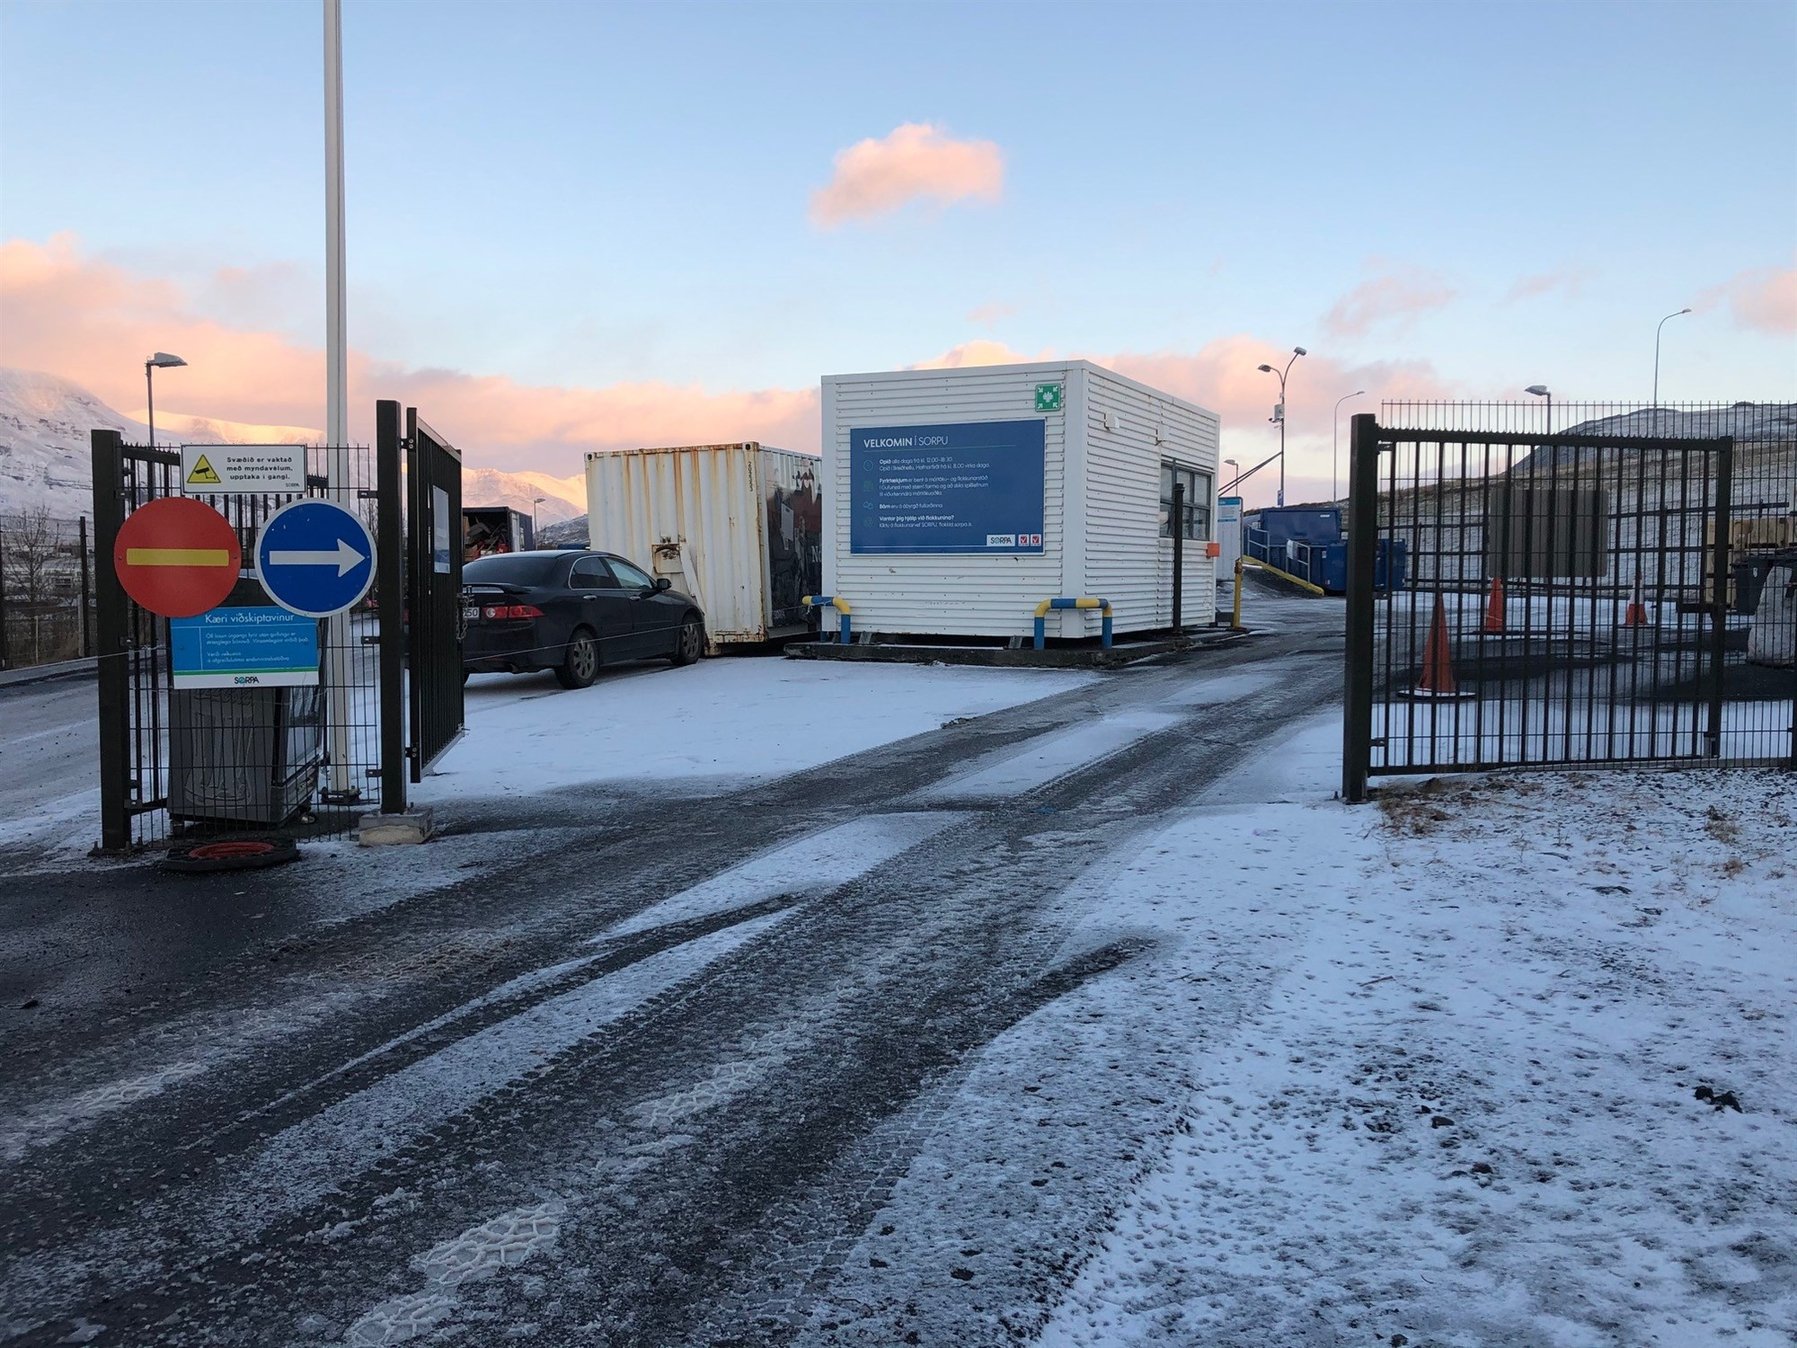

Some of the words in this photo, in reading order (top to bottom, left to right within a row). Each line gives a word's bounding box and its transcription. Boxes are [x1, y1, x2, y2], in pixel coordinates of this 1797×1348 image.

[864, 437, 913, 448] VELKOMIN
[918, 436, 949, 446] SORPU
[990, 536, 1013, 544] SORPA
[205, 614, 228, 624] Kæri
[230, 612, 294, 624] viðskiptavinur
[234, 676, 260, 685] SORPA
